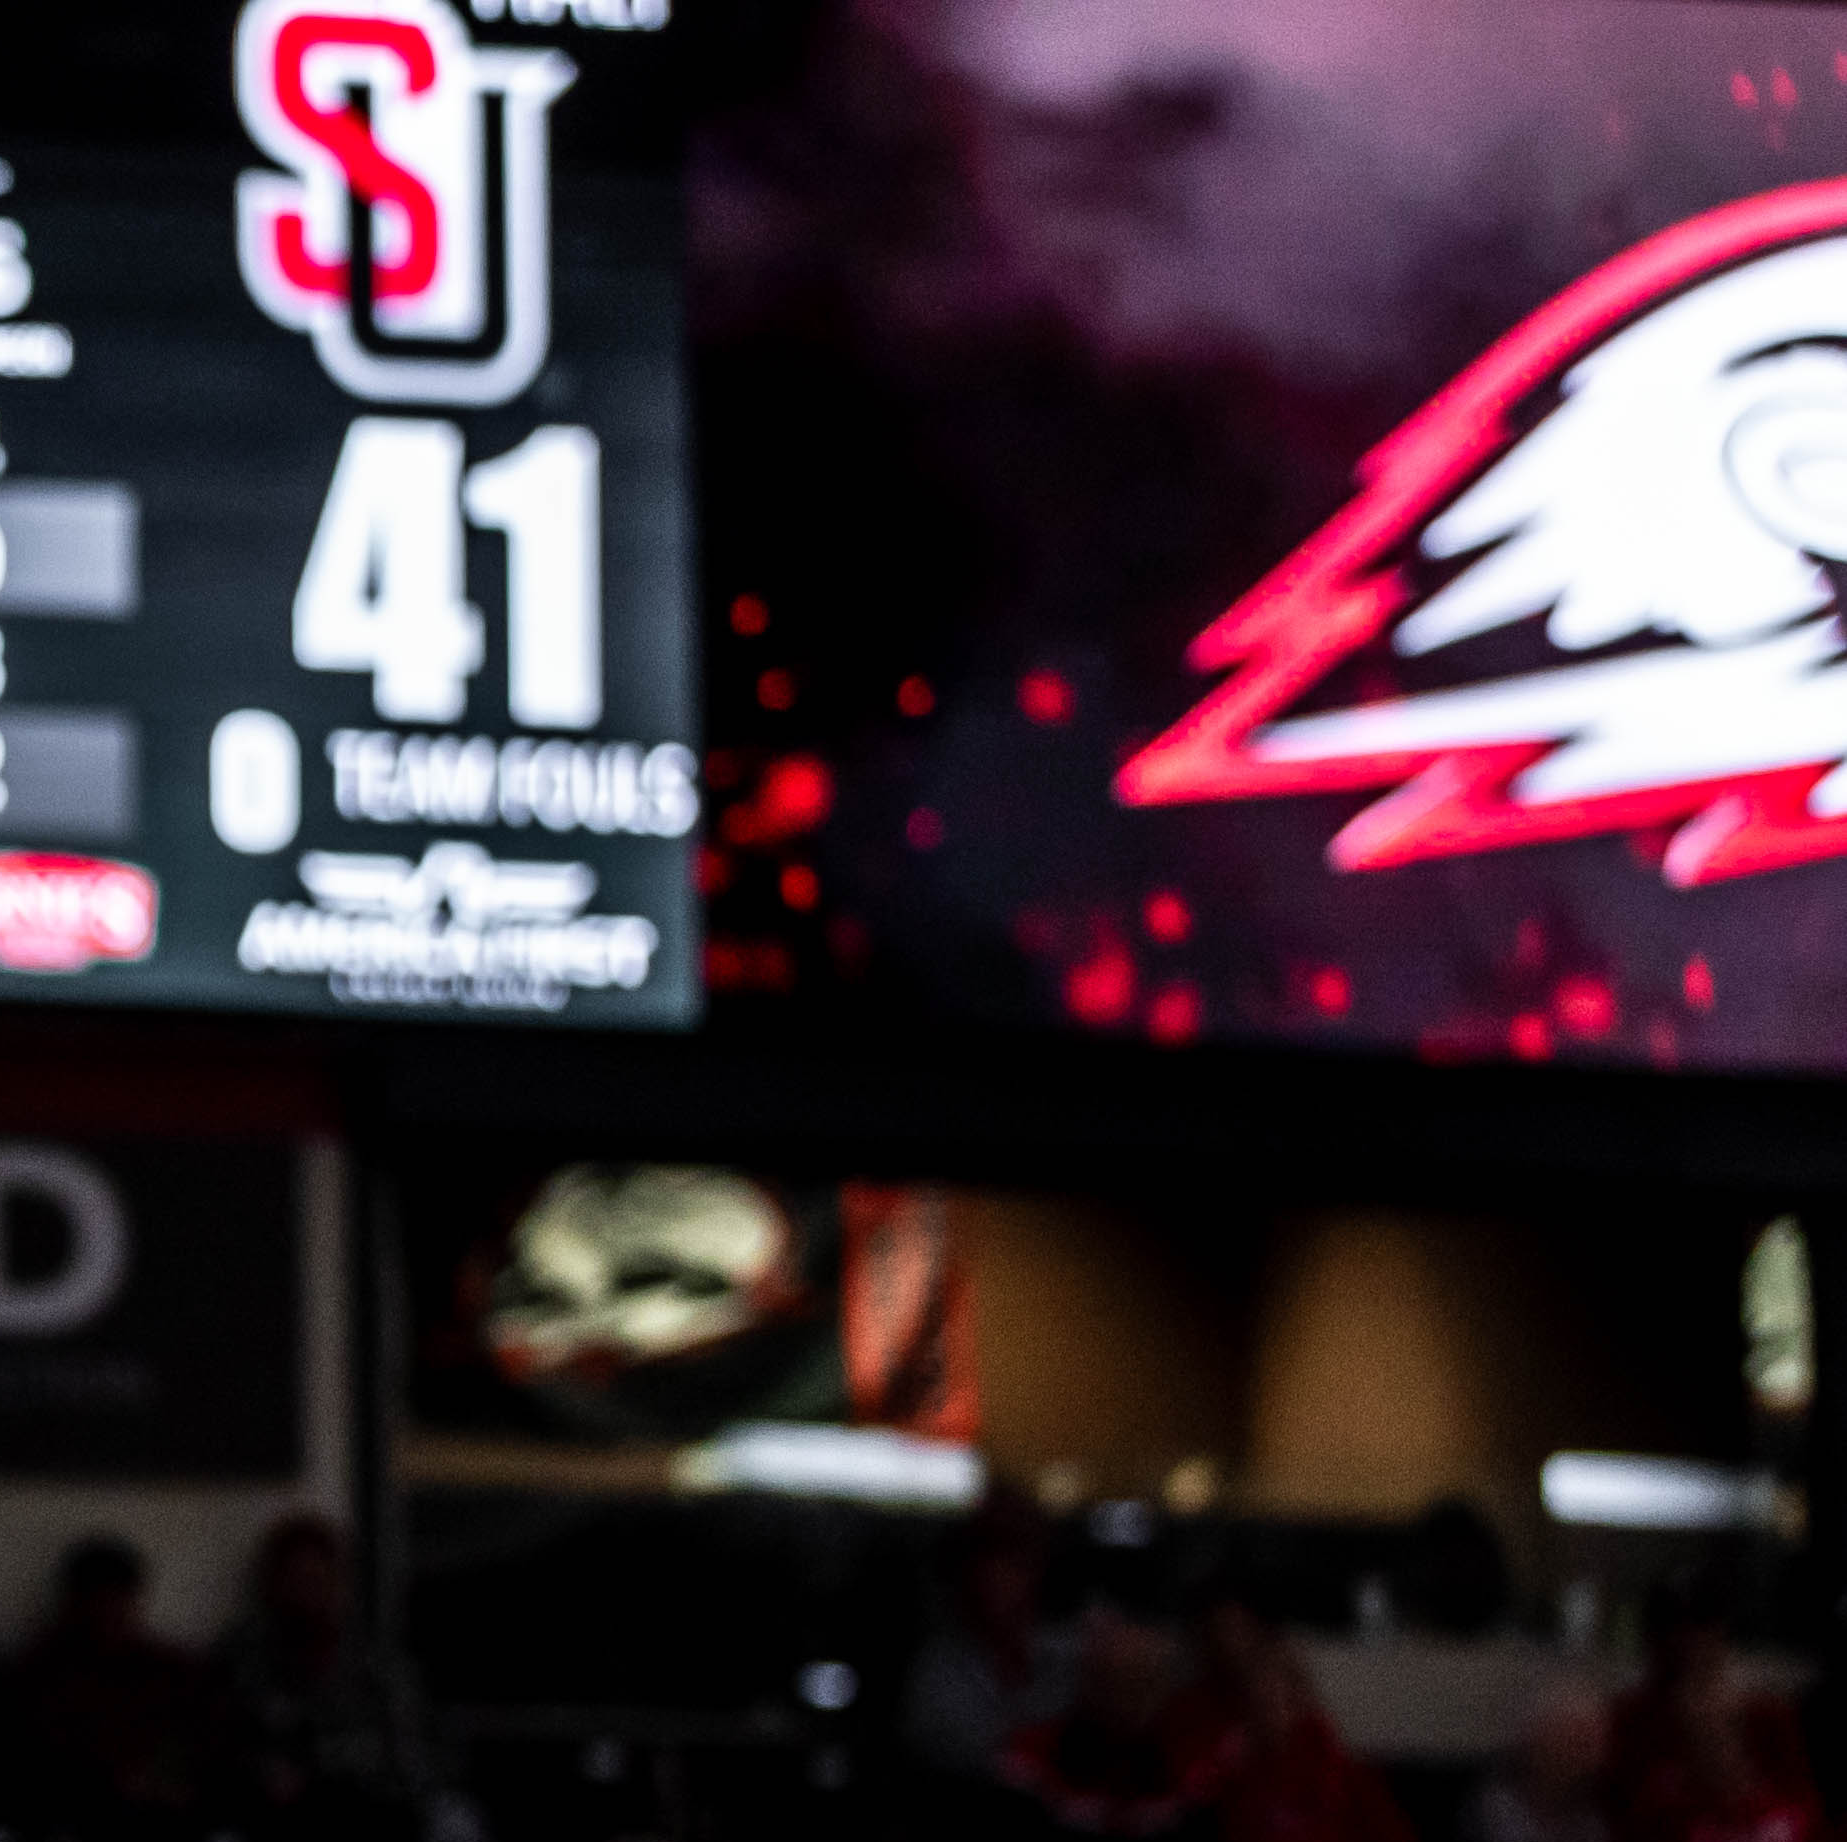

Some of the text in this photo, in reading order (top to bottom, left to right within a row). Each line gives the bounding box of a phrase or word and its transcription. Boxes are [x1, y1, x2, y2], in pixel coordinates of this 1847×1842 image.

[292, 415, 602, 731] 41
[210, 706, 699, 855] 0 TEAM FOULS
